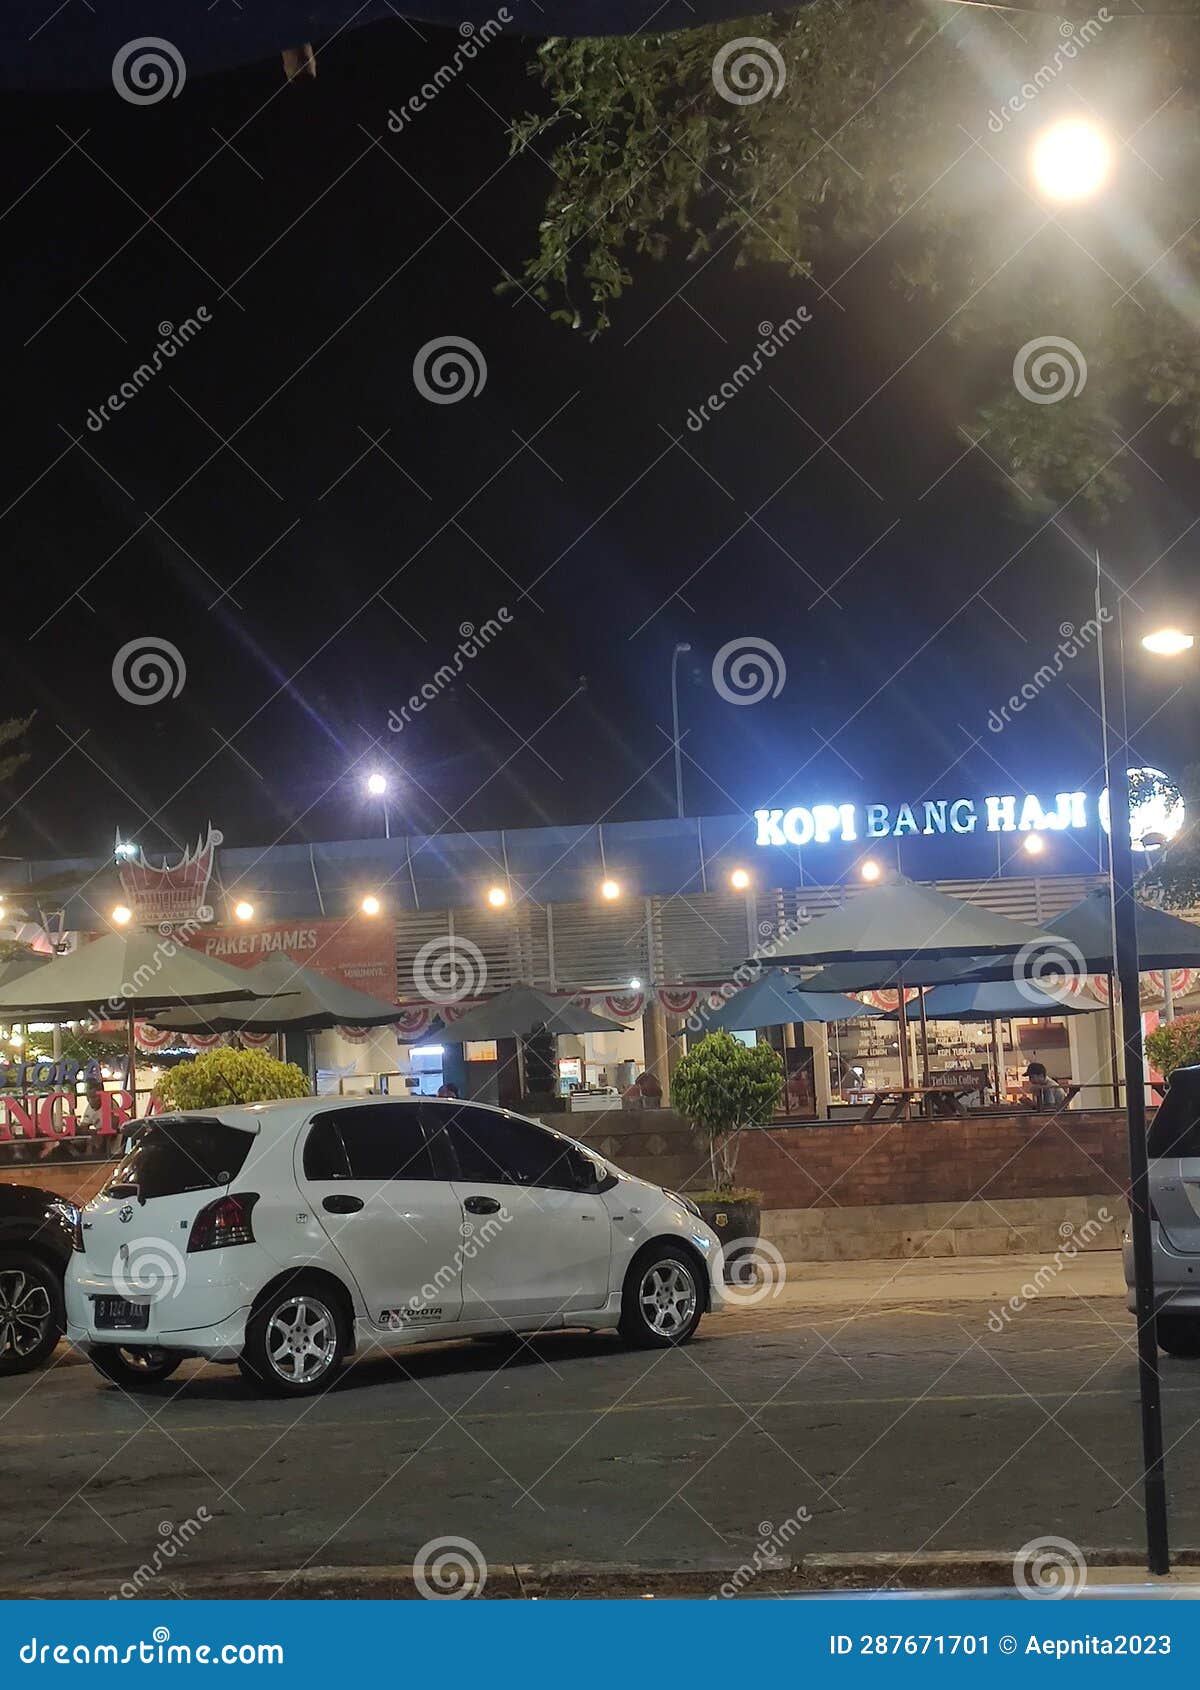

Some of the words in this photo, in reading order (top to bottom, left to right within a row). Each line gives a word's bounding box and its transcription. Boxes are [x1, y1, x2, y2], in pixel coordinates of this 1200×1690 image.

[754, 804, 857, 846] KOPI
[866, 799, 978, 838] BANG
[984, 791, 1088, 832] HAJI
[205, 935, 259, 956] PAKET
[262, 929, 318, 952] RAMES
[959, 1074, 979, 1085] Coffee
